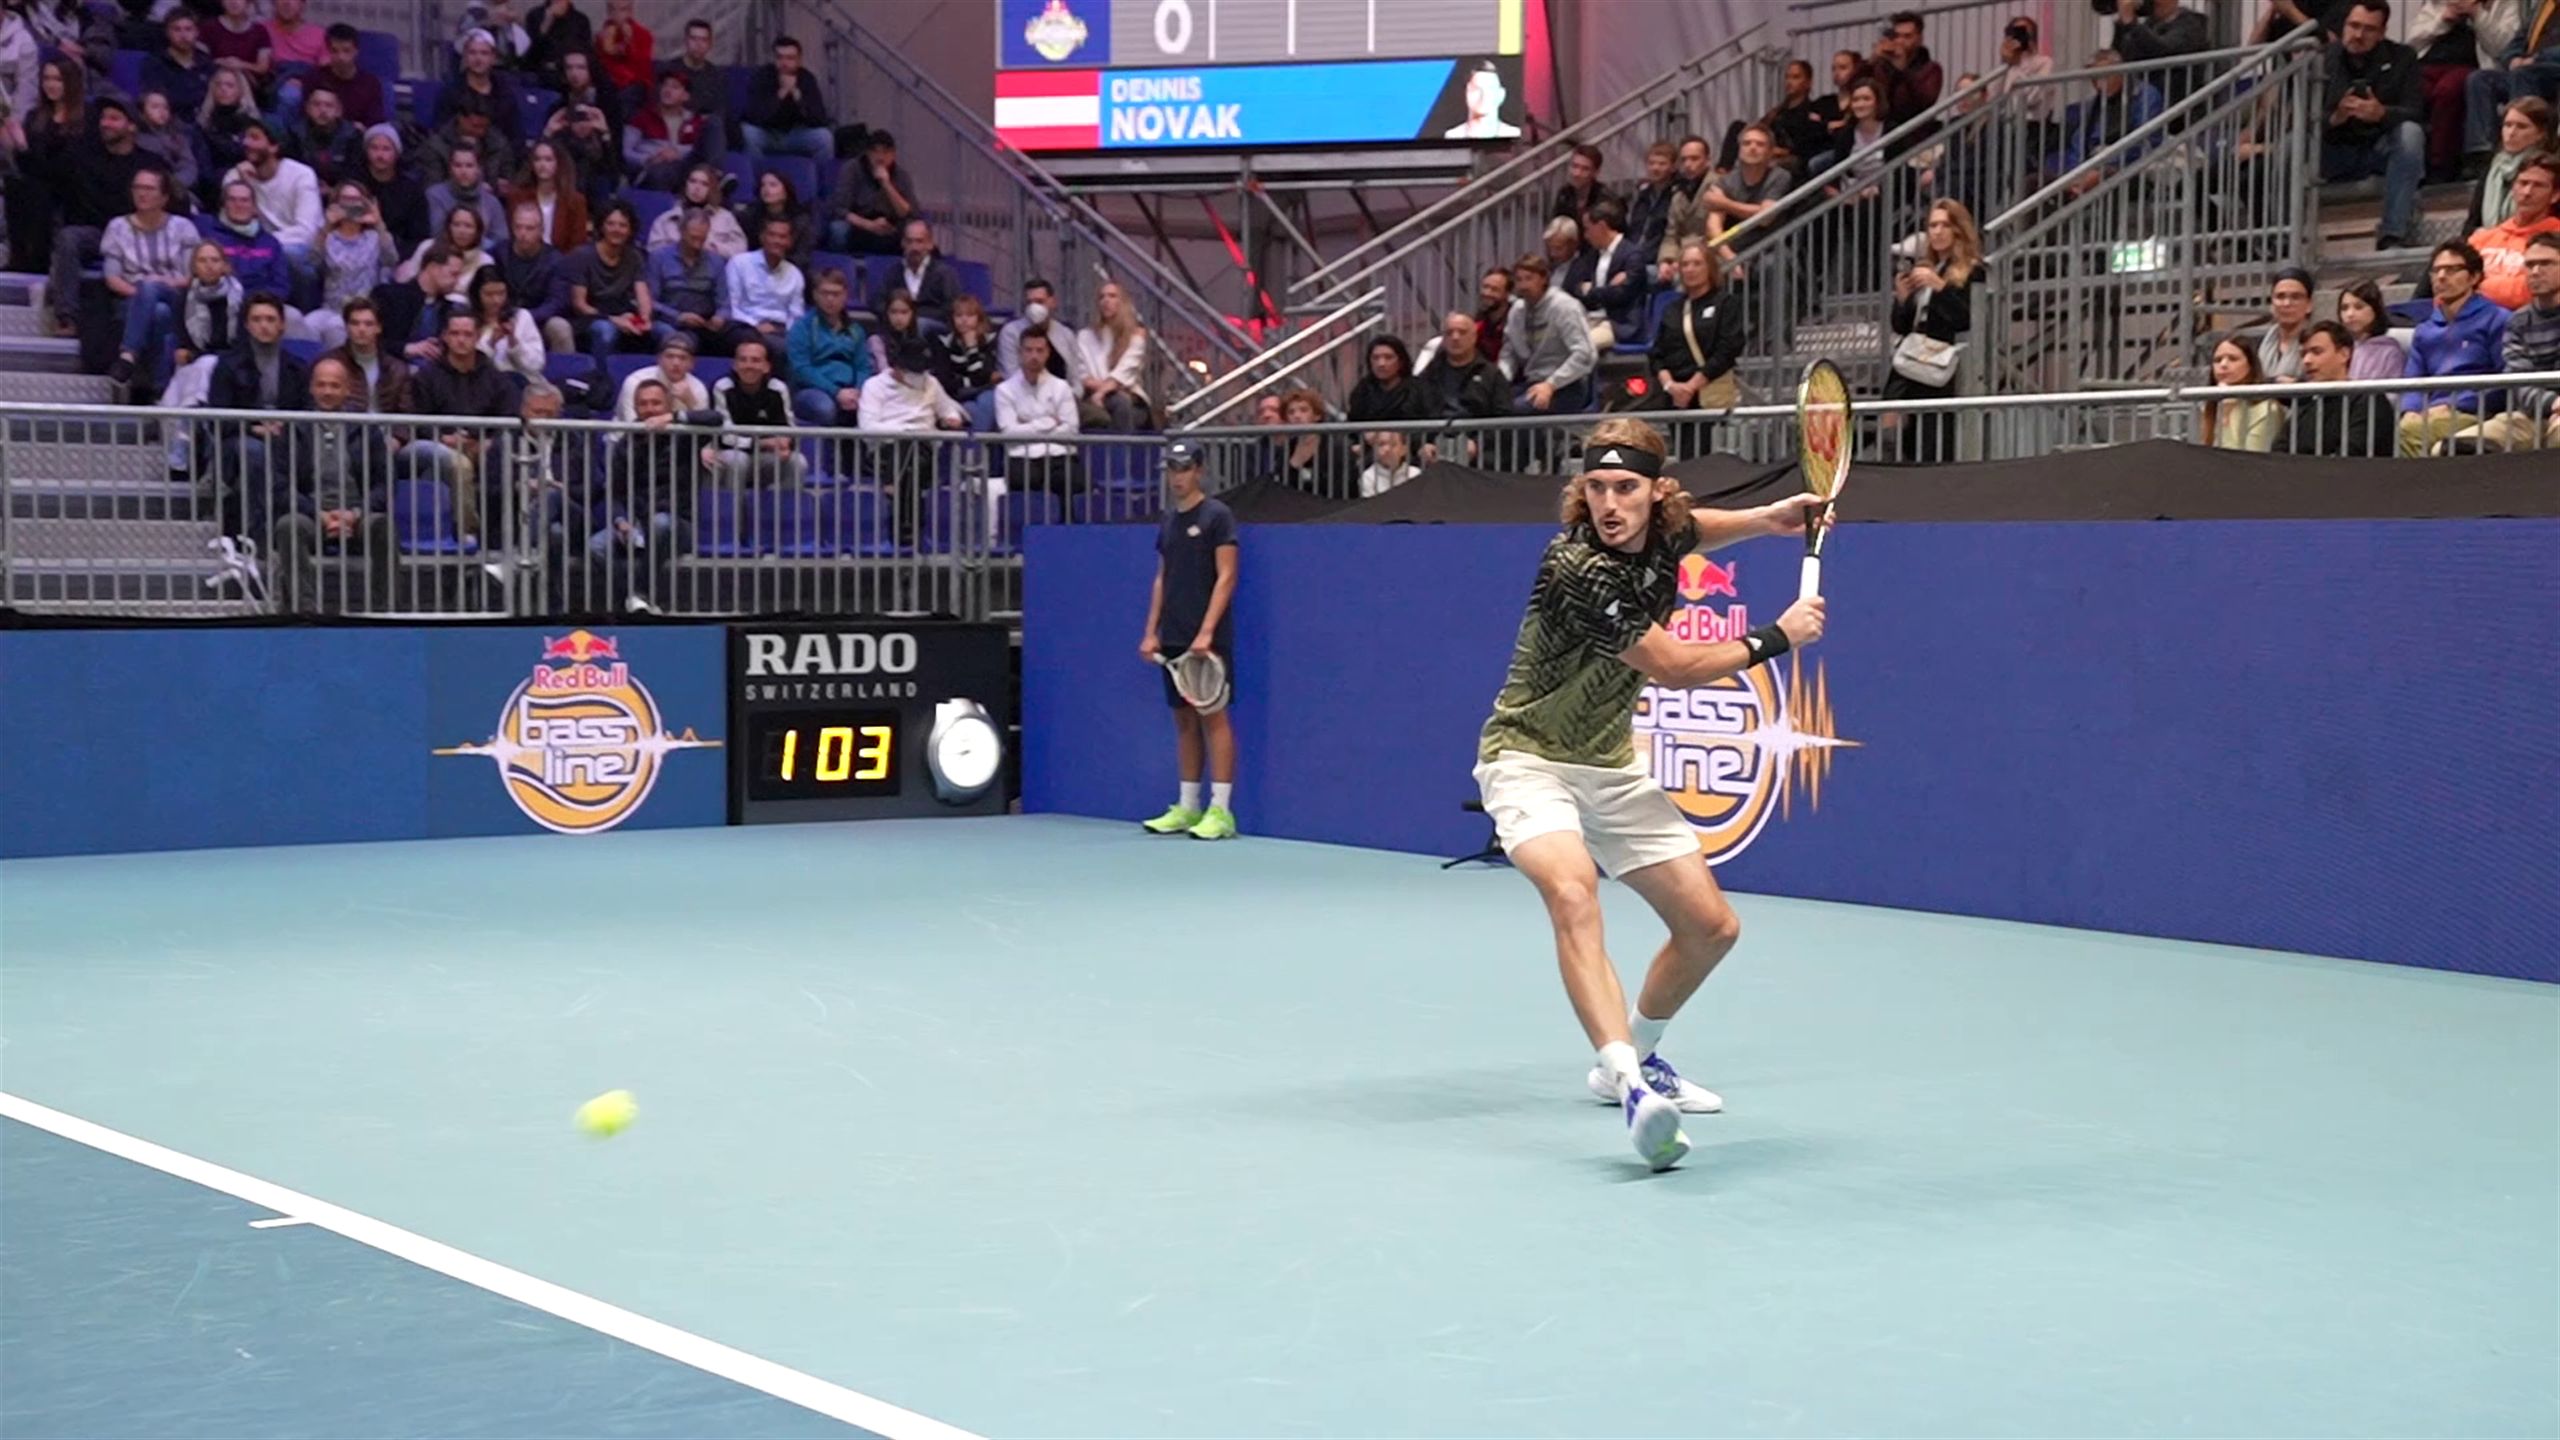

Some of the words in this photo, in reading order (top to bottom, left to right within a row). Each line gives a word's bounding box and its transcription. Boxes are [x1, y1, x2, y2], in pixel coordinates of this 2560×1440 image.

[1154, 0, 1192, 55] 0
[1111, 76, 1202, 103] DENNIS
[1111, 103, 1242, 142] NOVAK
[1697, 605, 1746, 642] Bull
[745, 633, 917, 676] RADO
[535, 664, 580, 689] Red
[583, 663, 626, 688] Bull
[745, 682, 917, 701] SWITZERLAND
[519, 696, 634, 747] bass
[544, 746, 634, 787] line
[1652, 732, 1752, 796] line
